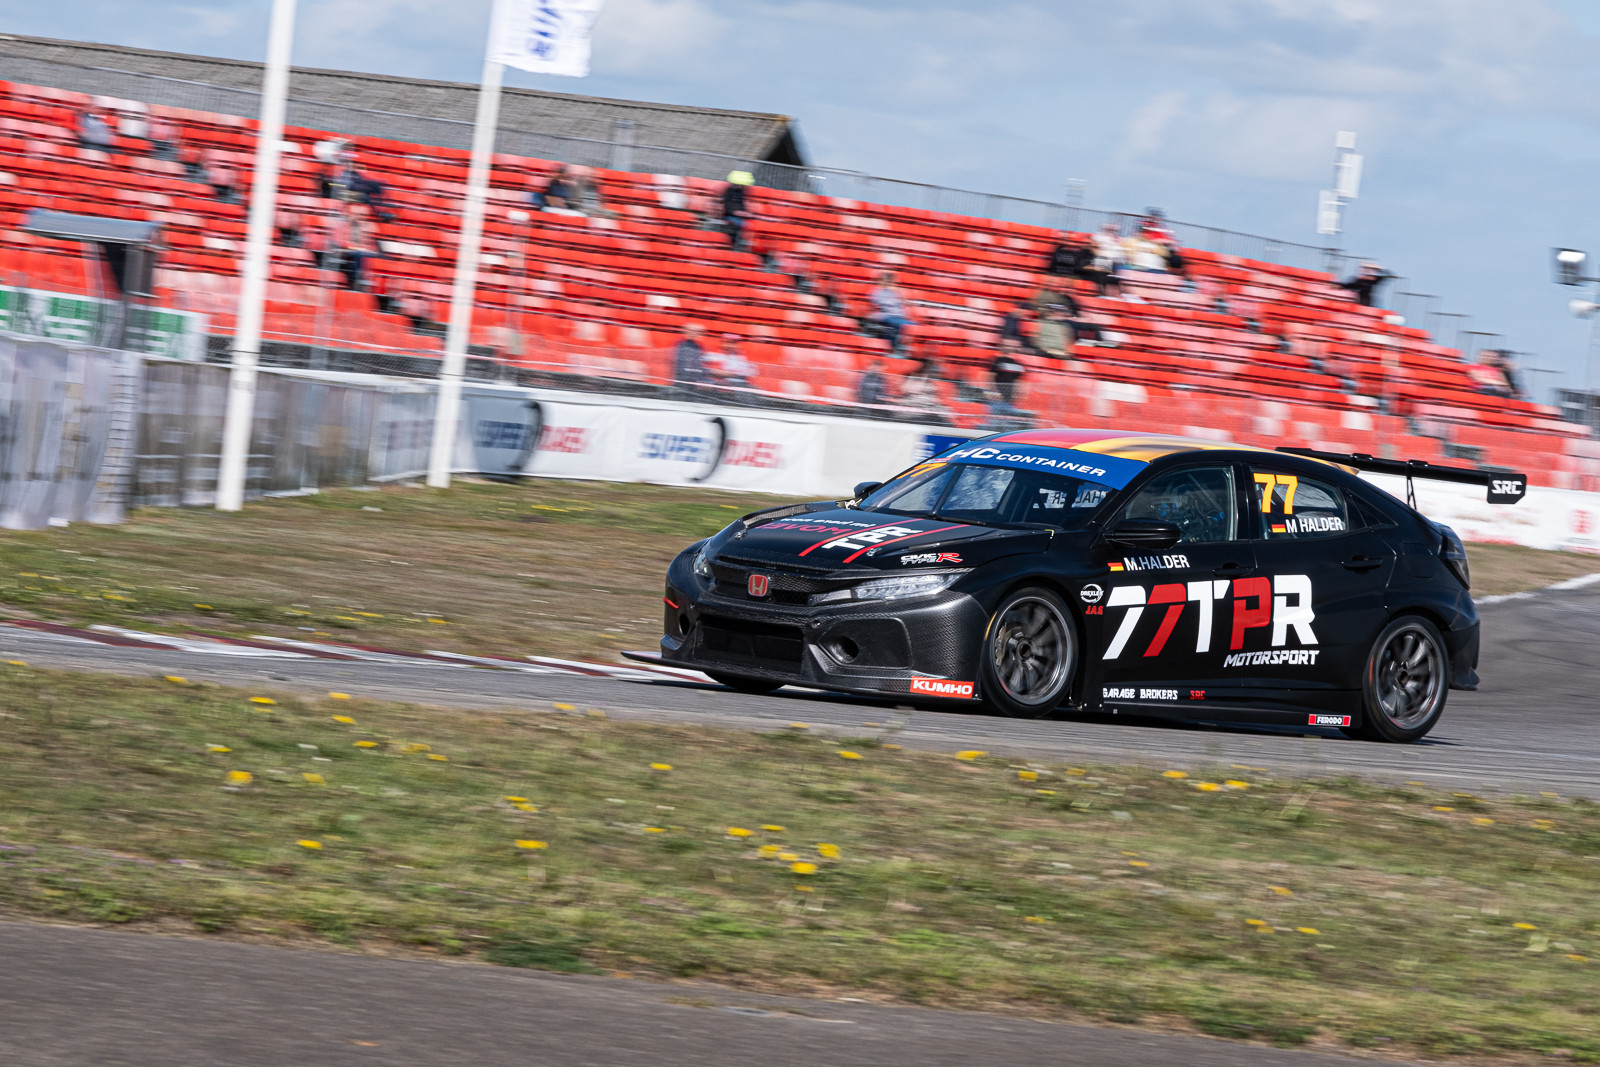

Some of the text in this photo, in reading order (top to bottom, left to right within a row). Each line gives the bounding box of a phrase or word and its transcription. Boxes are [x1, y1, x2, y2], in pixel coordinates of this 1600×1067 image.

[949, 448, 1000, 459] HC
[996, 453, 1107, 477] CONTAINER
[1253, 473, 1298, 515] 77
[1491, 480, 1523, 494] SRC
[1285, 516, 1345, 534] M HALDER
[936, 552, 964, 563] R
[1223, 650, 1320, 668] MOTORSPORT
[912, 679, 973, 695] KUMHO
[1103, 688, 1178, 700] GARAGE BROKERS
[1316, 716, 1343, 725] FERODO
